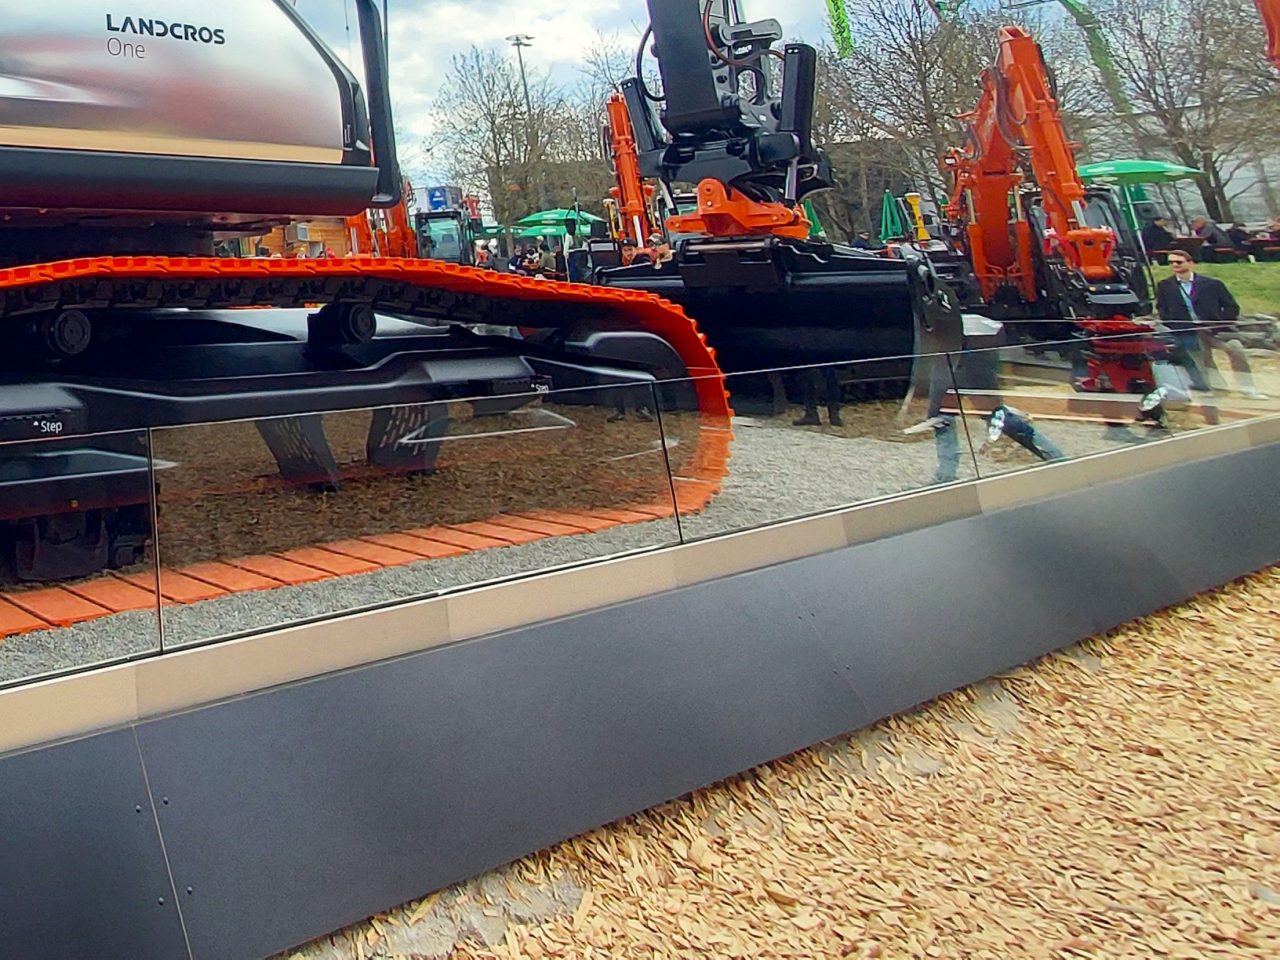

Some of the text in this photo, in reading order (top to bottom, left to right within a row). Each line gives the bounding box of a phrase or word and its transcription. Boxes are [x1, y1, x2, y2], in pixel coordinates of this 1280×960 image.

[105, 13, 226, 45] LANDCROS
[107, 37, 146, 59] One
[40, 420, 63, 434] Step
